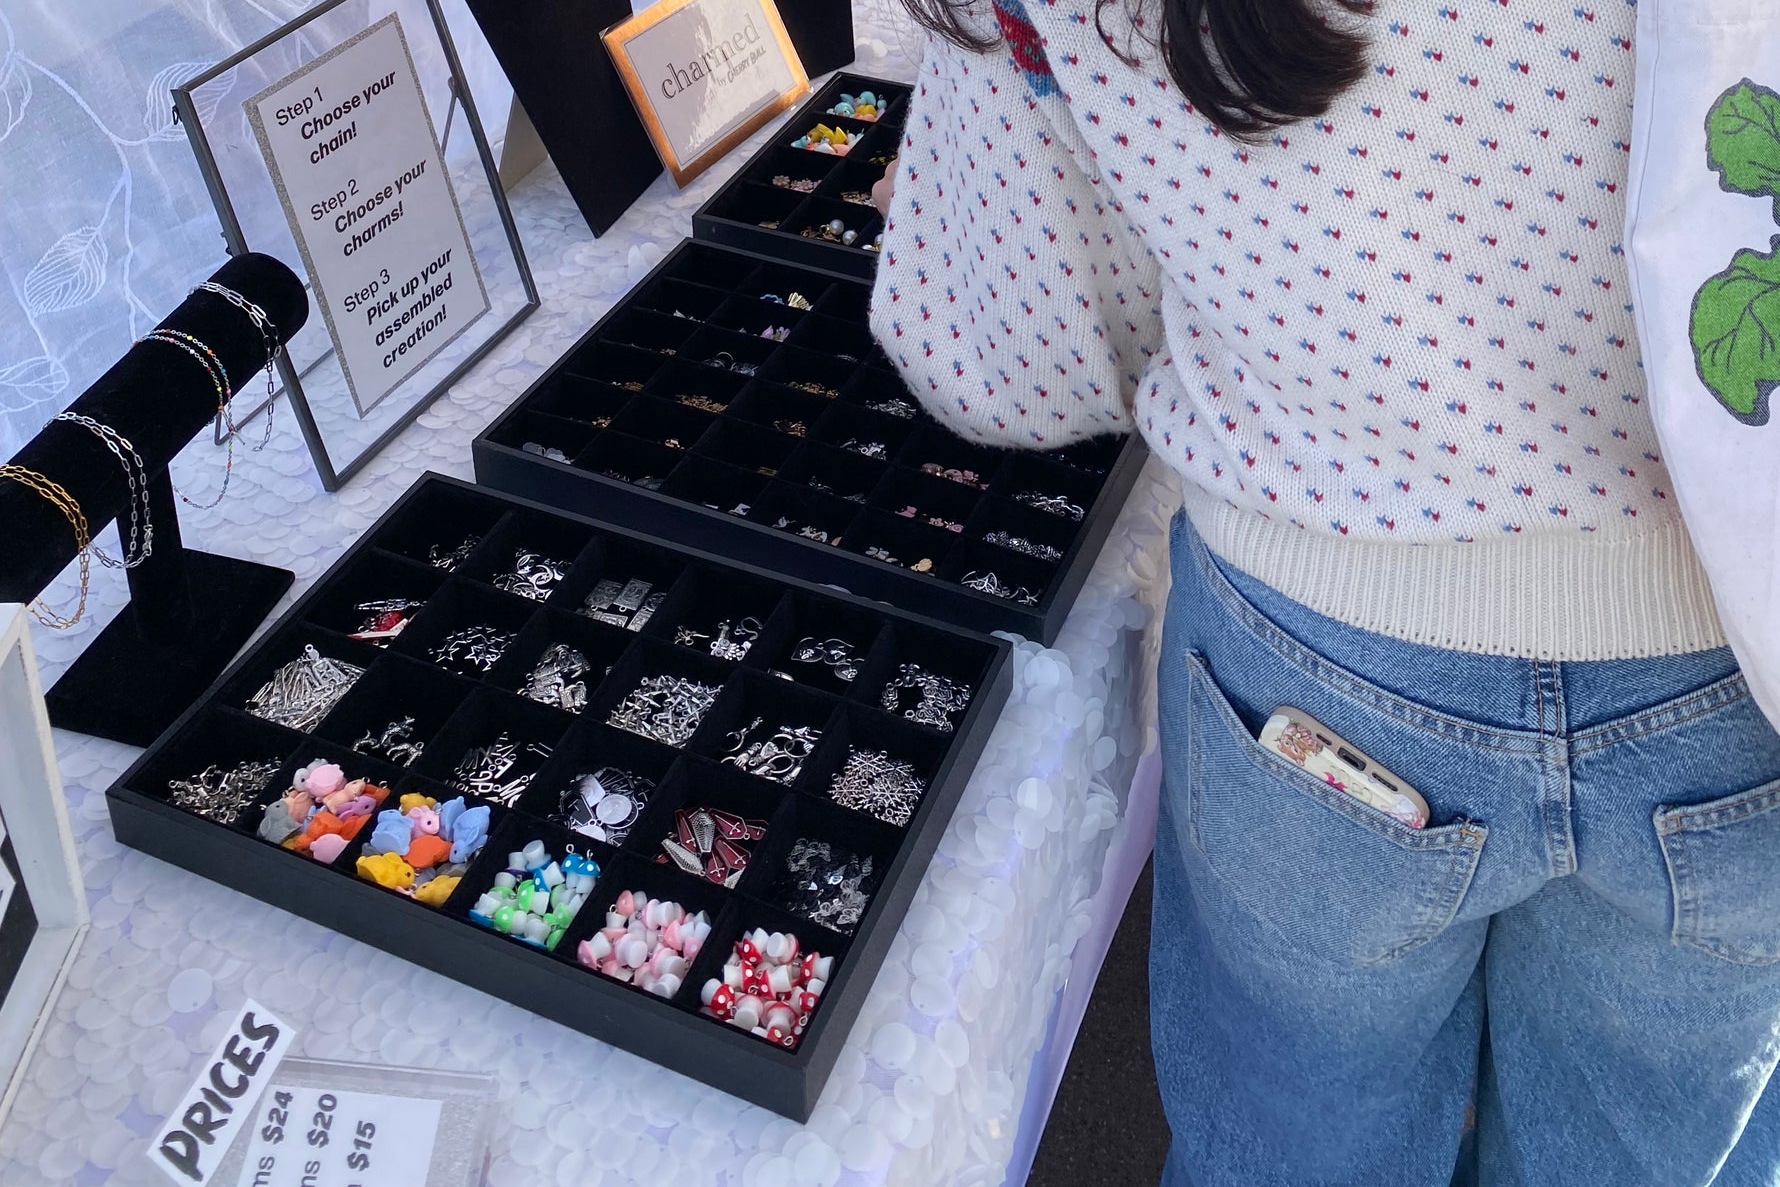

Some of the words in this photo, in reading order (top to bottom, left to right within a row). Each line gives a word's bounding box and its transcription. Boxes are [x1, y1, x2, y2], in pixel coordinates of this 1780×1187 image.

[661, 12, 760, 99] charmed
[275, 96, 312, 126] Step
[314, 86, 323, 102] 1
[301, 94, 361, 140] Choose
[363, 71, 397, 104] your
[310, 121, 358, 165] chain!
[310, 190, 347, 221] Step
[348, 179, 359, 195] 2
[335, 185, 393, 234] Choose
[395, 160, 427, 194] your
[343, 201, 404, 257] charms!
[343, 280, 379, 313] Step
[380, 269, 390, 285] 3
[367, 292, 400, 326] Pick
[401, 276, 420, 300] up
[421, 249, 453, 282] your
[375, 273, 453, 347] assembled
[383, 304, 448, 368] creation!
[159, 1010, 281, 1182] PRICES
[261, 1091, 294, 1145] $24
[307, 1093, 337, 1149] $20
[347, 1120, 376, 1172] $15
